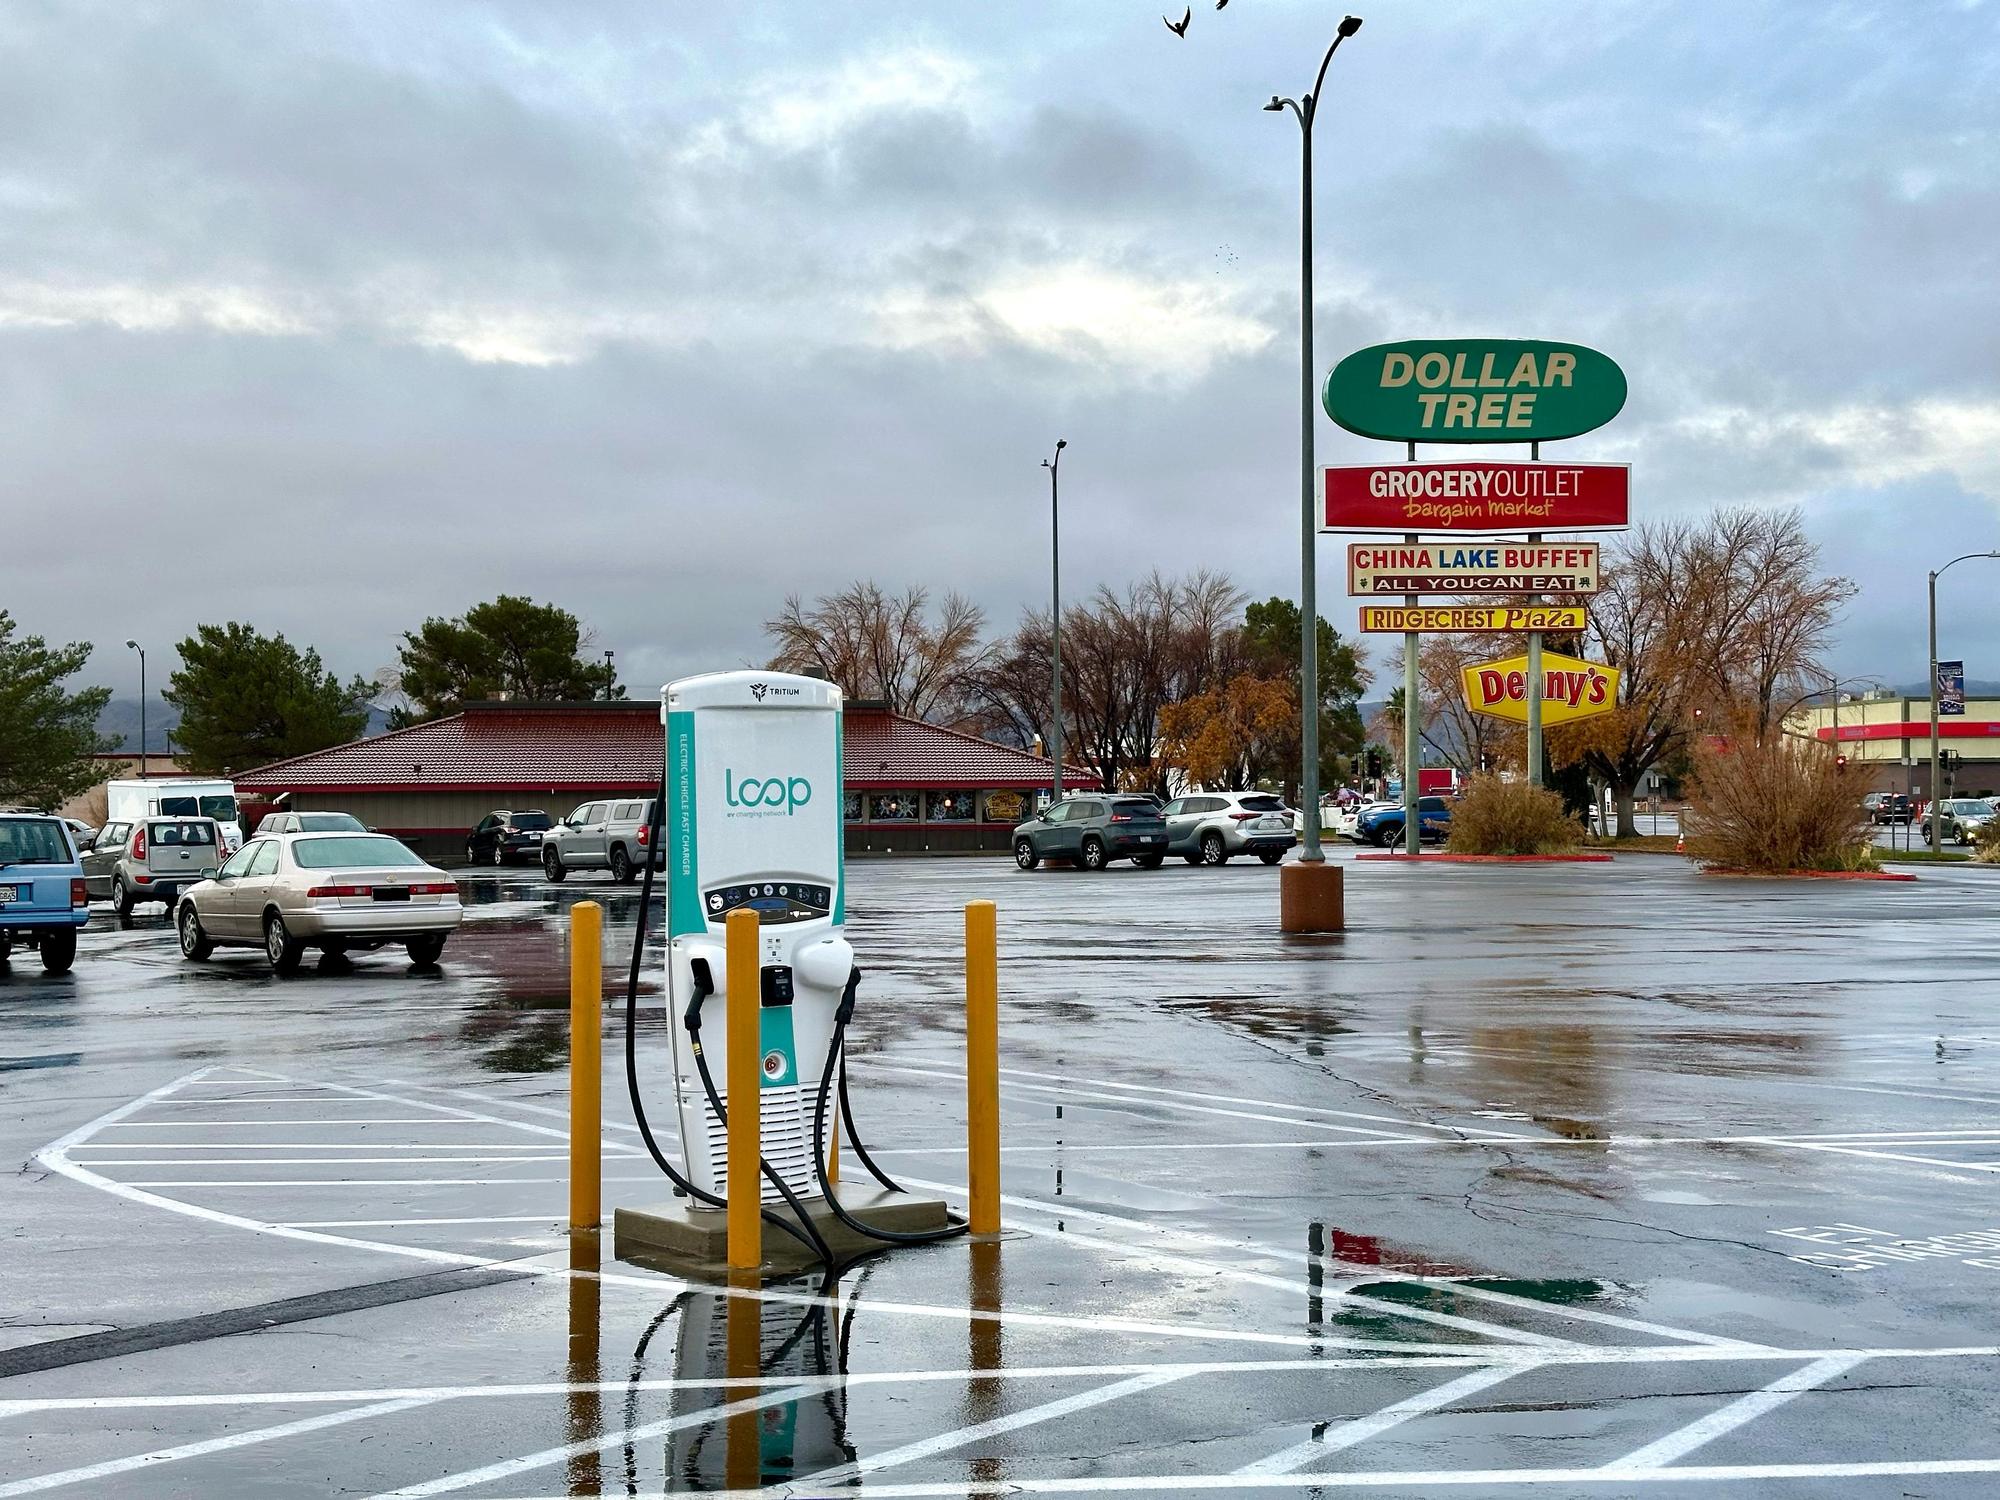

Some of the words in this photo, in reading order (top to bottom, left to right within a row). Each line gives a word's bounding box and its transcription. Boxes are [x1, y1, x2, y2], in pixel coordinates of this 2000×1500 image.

[1380, 352, 1576, 388] DOLLAR
[1418, 393, 1537, 428] TREE
[1402, 493, 1482, 526] bargain
[1355, 550, 1433, 569] CHINA
[1439, 549, 1499, 569] LAKE
[1504, 549, 1594, 569] BUFFET
[1375, 578, 1420, 591] ALL
[1531, 577, 1575, 589] EAT
[1373, 610, 1496, 629] RIDGECREST
[769, 688, 800, 696] TRITIUM
[680, 733, 689, 773] ELECTRIC
[681, 774, 689, 810] VEHICLE
[725, 768, 812, 816] loop
[682, 811, 690, 833] FAST
[682, 834, 690, 876] CHARGER
[1766, 1222, 1900, 1245] EV
